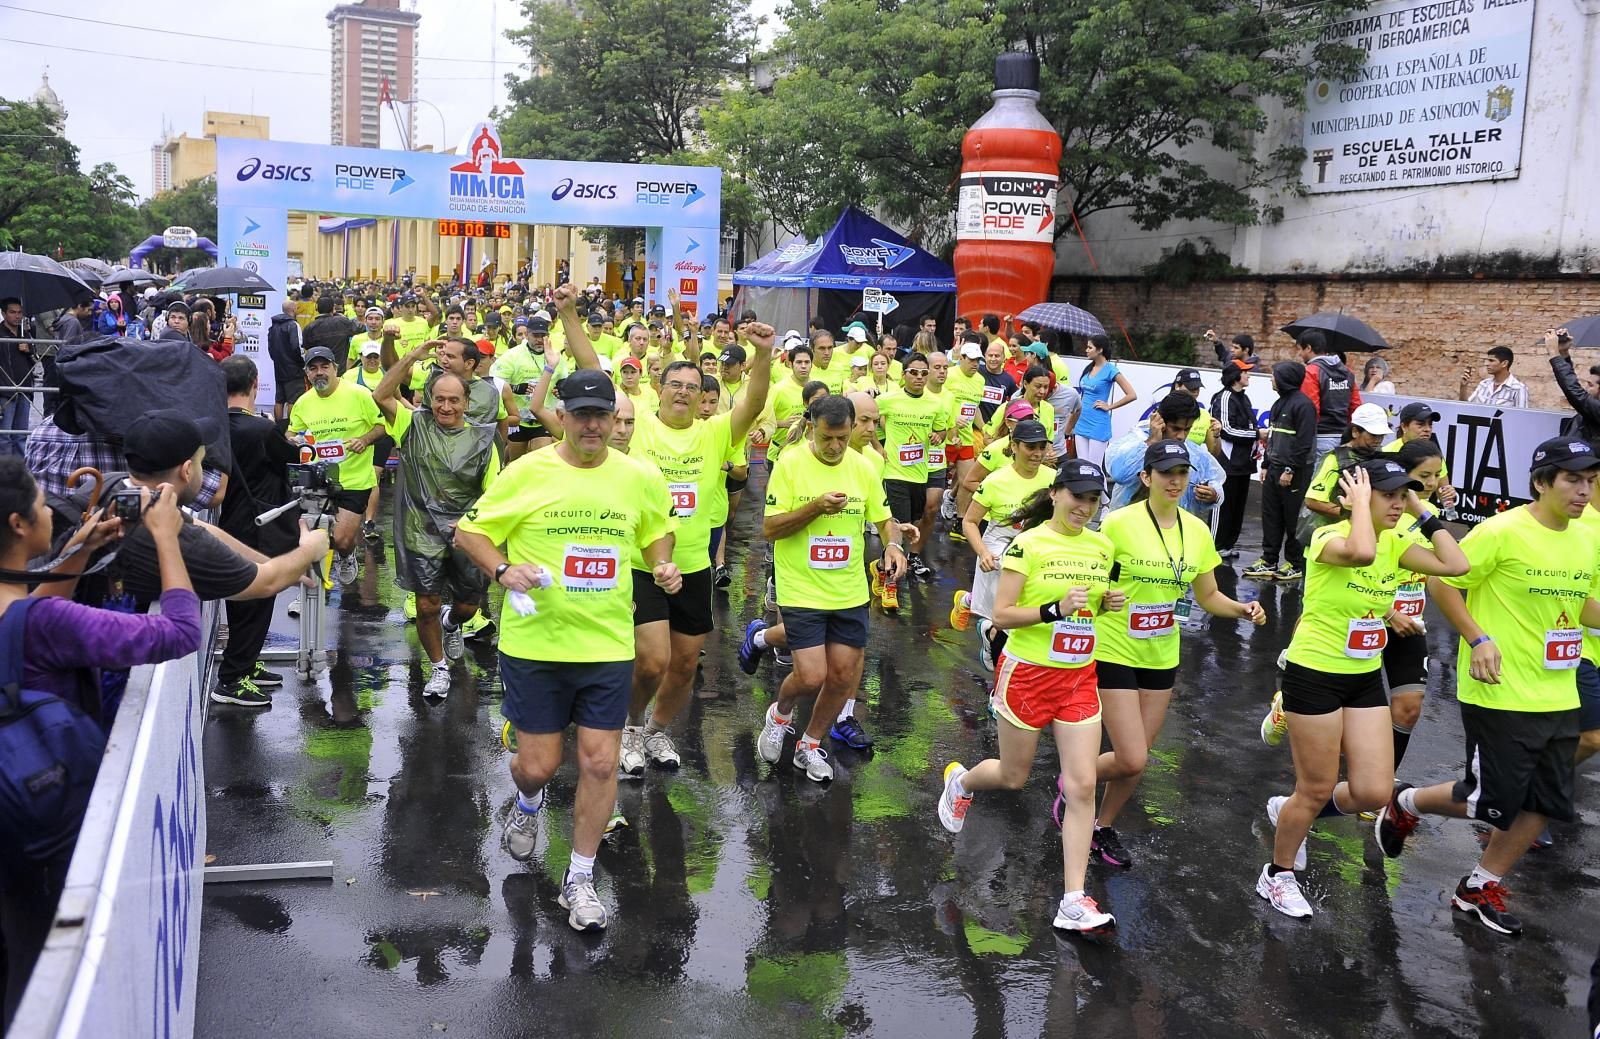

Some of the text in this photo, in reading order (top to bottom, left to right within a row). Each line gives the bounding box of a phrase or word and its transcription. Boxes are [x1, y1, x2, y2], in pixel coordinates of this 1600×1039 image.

[1322, 15, 1382, 41] ROGRAMA
[1389, 10, 1405, 29] DE
[1412, 0, 1475, 25] ESCUELAS
[1357, 17, 1471, 51] EN IBEROAMERICA
[1396, 53, 1463, 77] ESPAÑOLA
[1469, 46, 1488, 65] DE
[1340, 63, 1521, 103] COOPERACION INTERNACIONAL
[1310, 100, 1481, 136] MUNICIPALIDAD DE ASUNCION
[1343, 128, 1502, 157] ESCUELA TALLER
[1358, 147, 1472, 168] DE ASUNCION
[335, 164, 406, 180] POWER
[1340, 171, 1386, 185] RESCATANDO
[1390, 170, 1398, 180] EL
[1402, 165, 1451, 180] PATRIMONIO
[335, 176, 374, 190] ADE
[636, 181, 698, 194] POWER
[636, 194, 670, 204] ADE
[449, 203, 476, 212] CIUDAD
[984, 201, 1050, 217] POWER
[984, 215, 1025, 228] ADE
[841, 246, 901, 257] POWER
[864, 296, 894, 304] POWER
[547, 526, 625, 537] POWERADE
[817, 548, 844, 559] 514
[574, 560, 608, 576] 145
[1130, 559, 1172, 568] CIRCUITO
[1526, 569, 1567, 577] CIRCUITO
[1400, 603, 1420, 614] 251
[1138, 614, 1170, 628] 267
[1063, 637, 1090, 651] 147
[1362, 633, 1380, 647] 52
